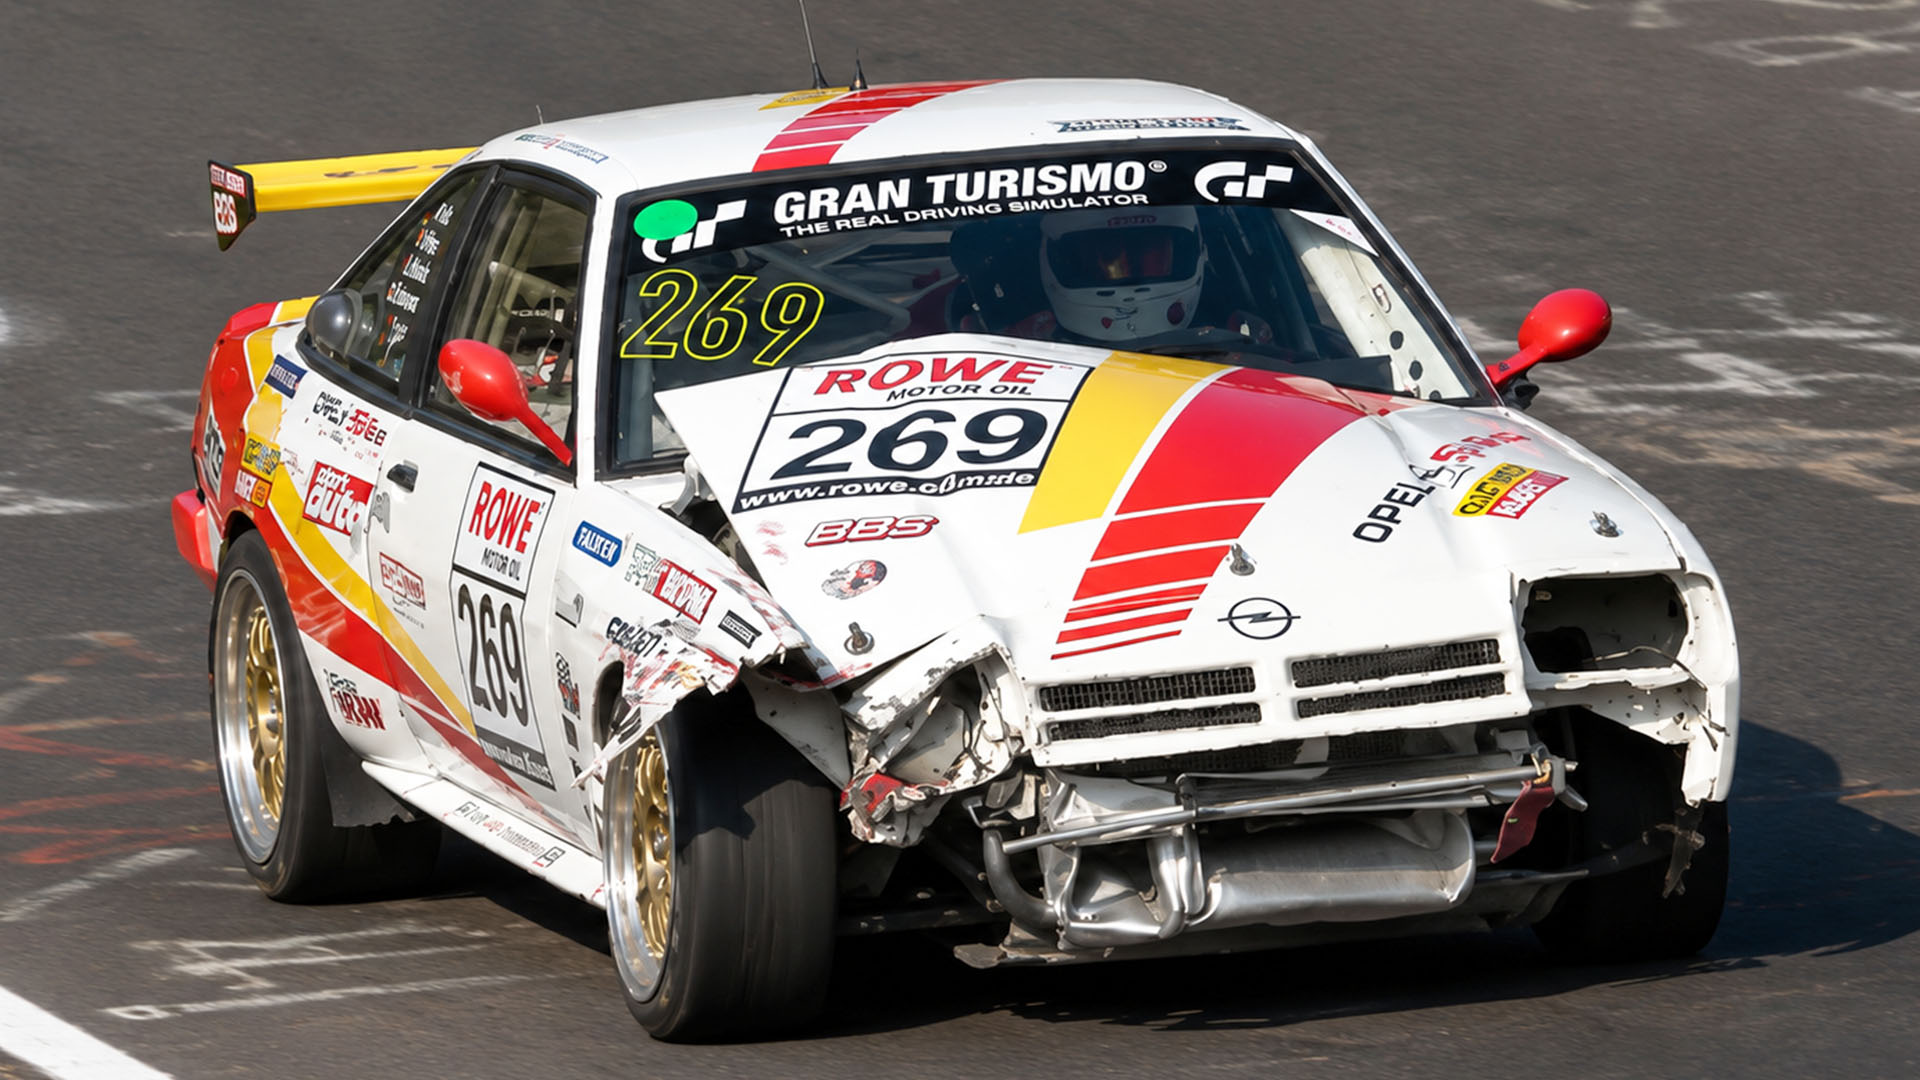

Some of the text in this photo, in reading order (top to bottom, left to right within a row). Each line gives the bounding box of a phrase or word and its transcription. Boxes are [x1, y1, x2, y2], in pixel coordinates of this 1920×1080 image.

[773, 160, 1146, 226] GRAN TURISMO
[779, 194, 1150, 239] THE REAL DRIVING SIMULATOR
[619, 268, 826, 368] 269
[813, 356, 1055, 396] ROWE
[886, 384, 1032, 403] MOTOR OIL
[769, 407, 1049, 481] 269
[467, 480, 541, 555] ROWE
[804, 514, 940, 548] BBS
[1352, 482, 1437, 544] OPEL
[457, 582, 530, 728] 269
